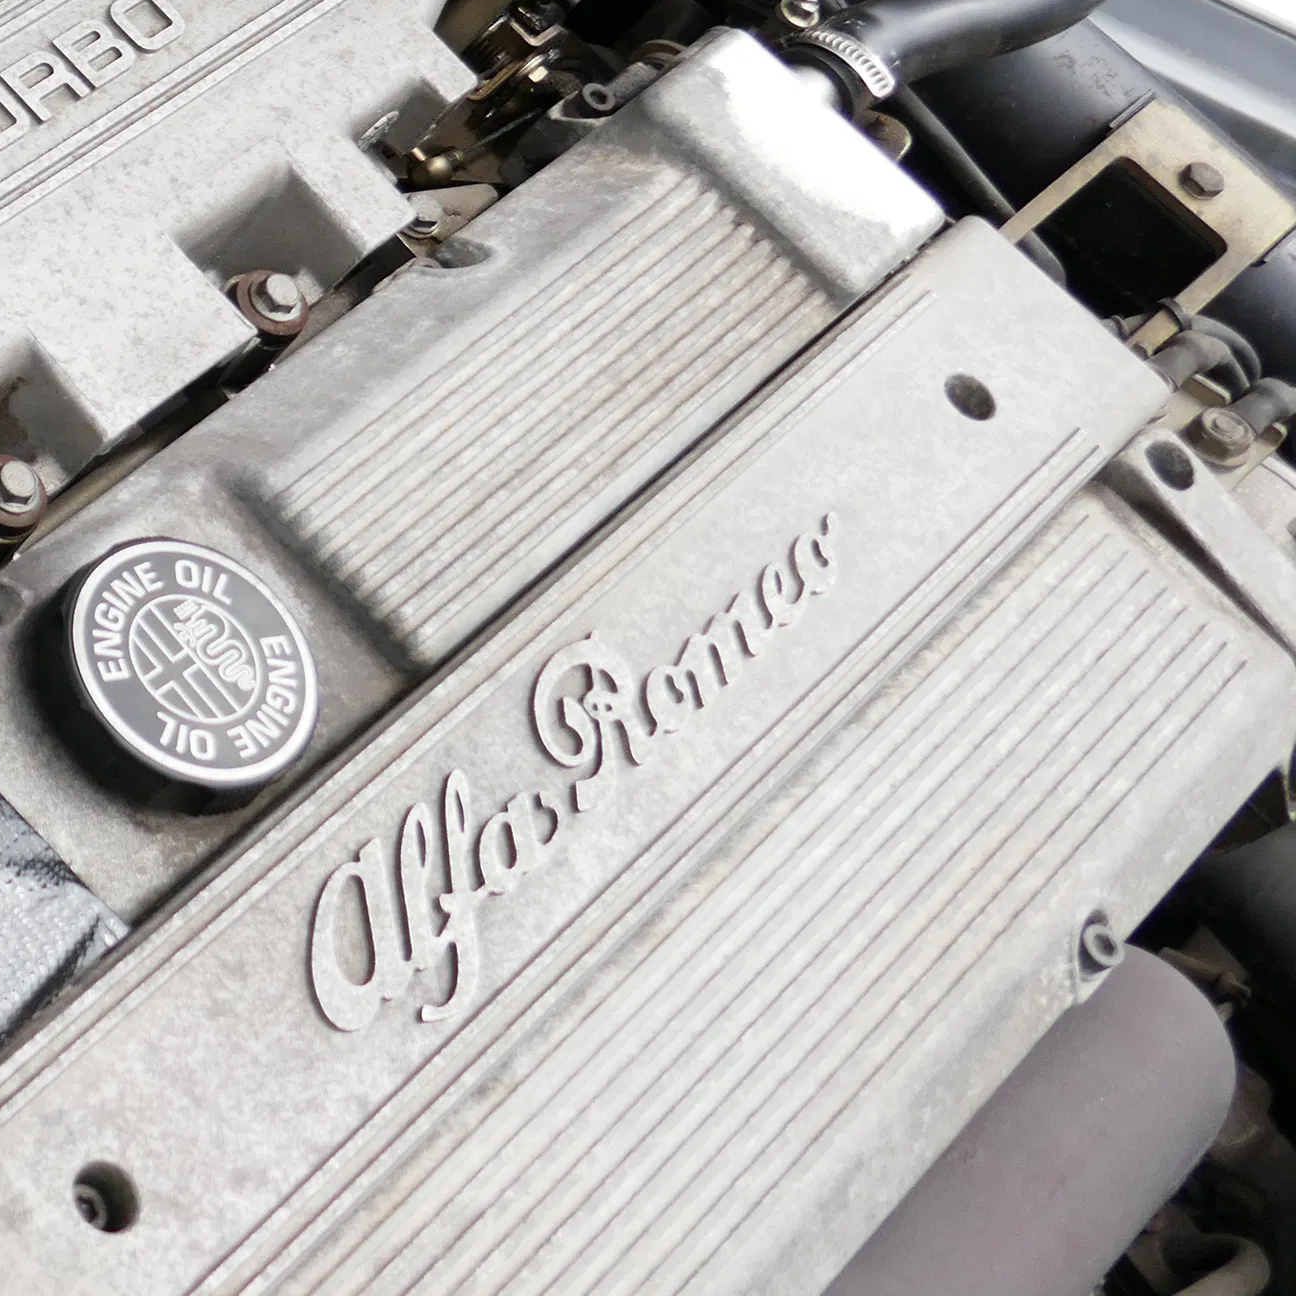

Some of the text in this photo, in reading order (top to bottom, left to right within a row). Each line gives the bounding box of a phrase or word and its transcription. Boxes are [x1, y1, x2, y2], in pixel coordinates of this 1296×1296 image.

[93, 559, 233, 682] ENGINE OIL
[157, 634, 298, 761] ENGINE OIL
[310, 510, 838, 1032] Alfa Romeo
